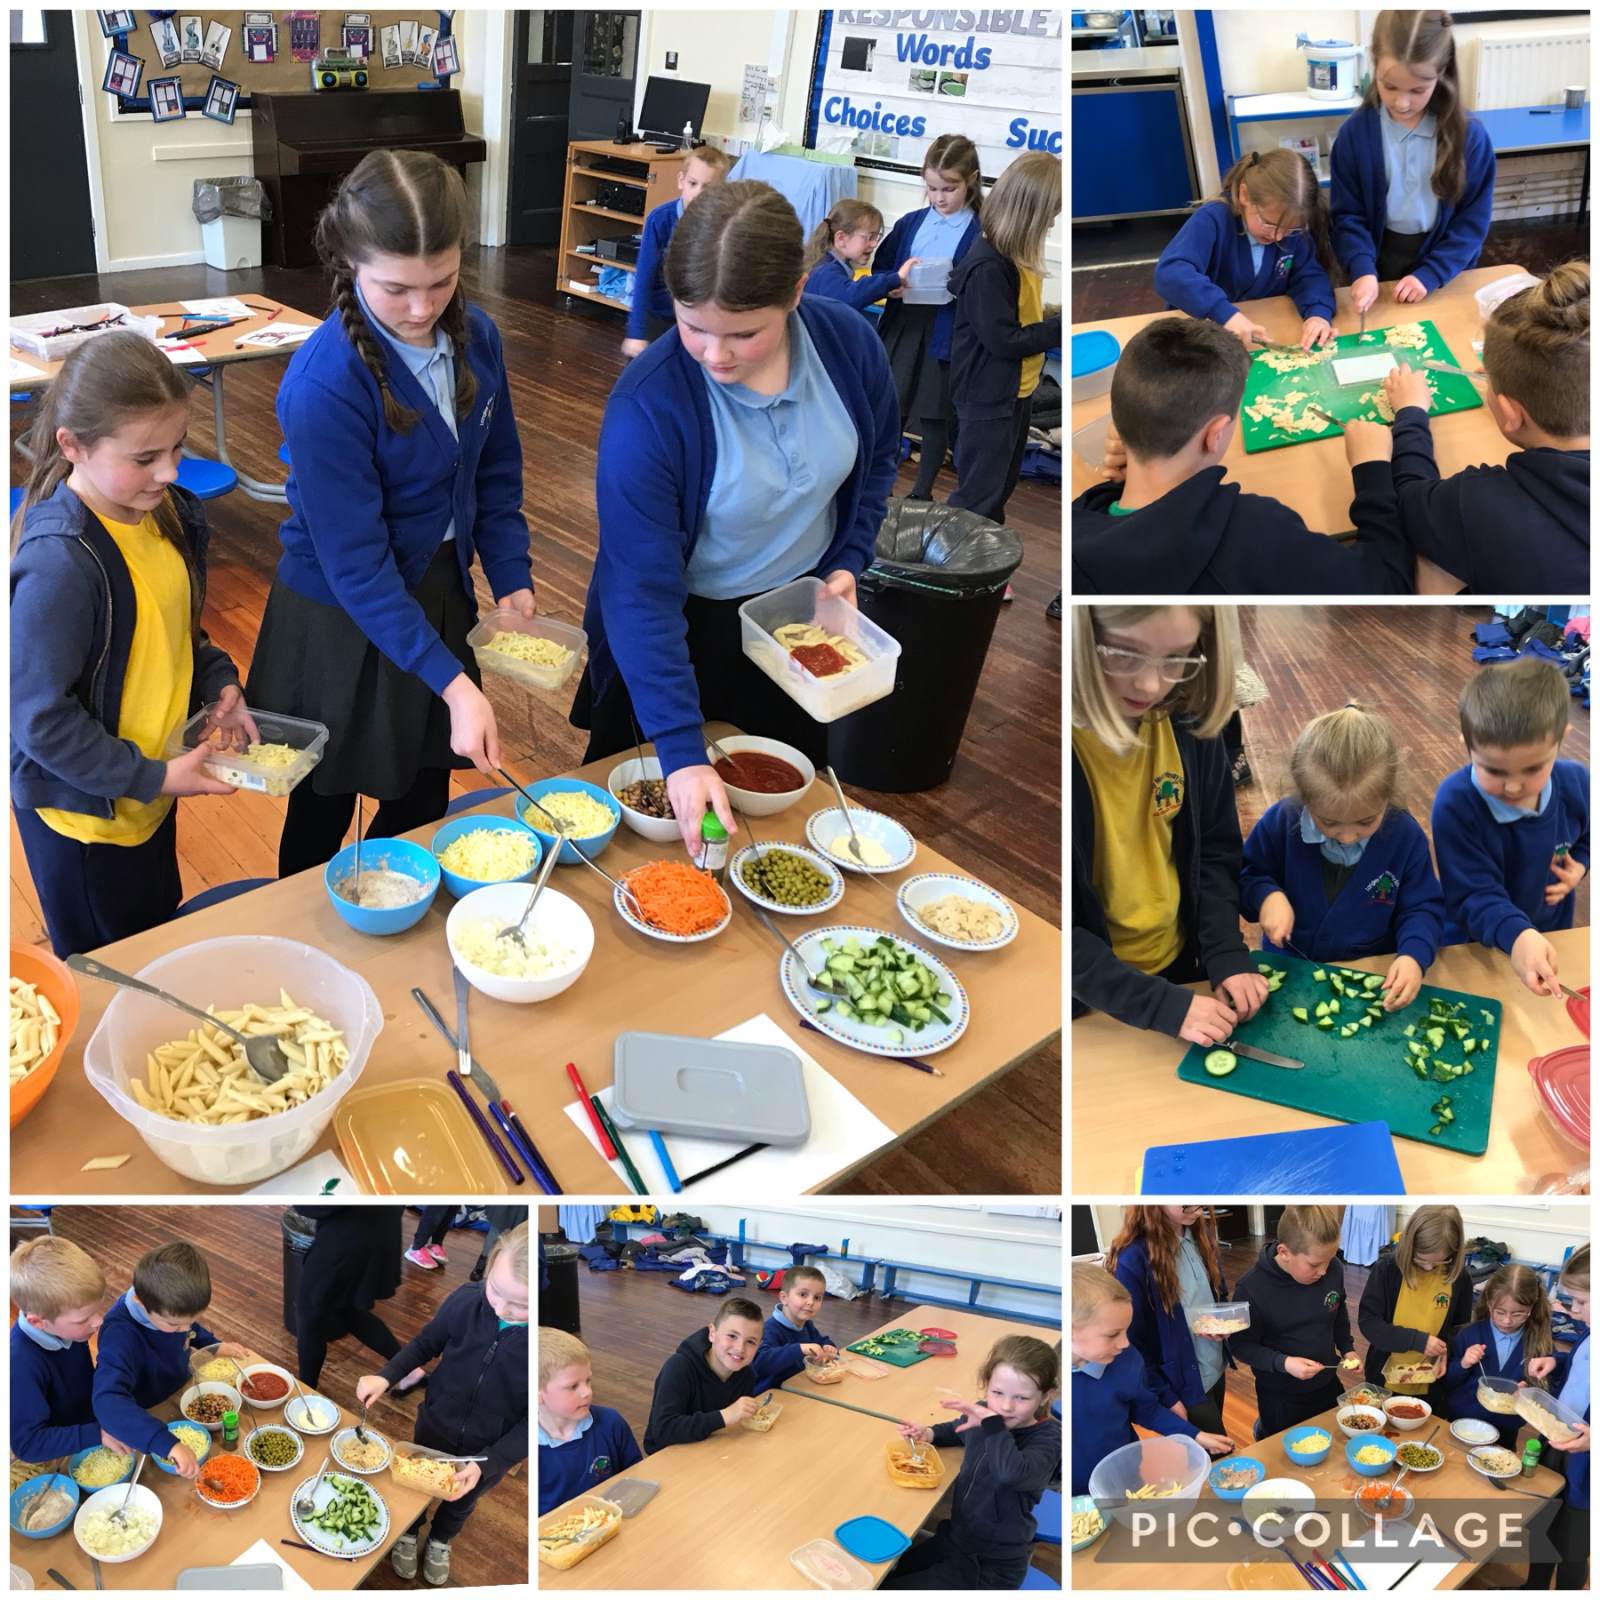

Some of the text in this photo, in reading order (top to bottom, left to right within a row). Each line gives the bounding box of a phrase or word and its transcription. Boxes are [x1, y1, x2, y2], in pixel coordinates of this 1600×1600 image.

[838, 9, 1048, 35] RESPONSIBLE
[897, 33, 992, 70] Words
[824, 97, 926, 137] Choices
